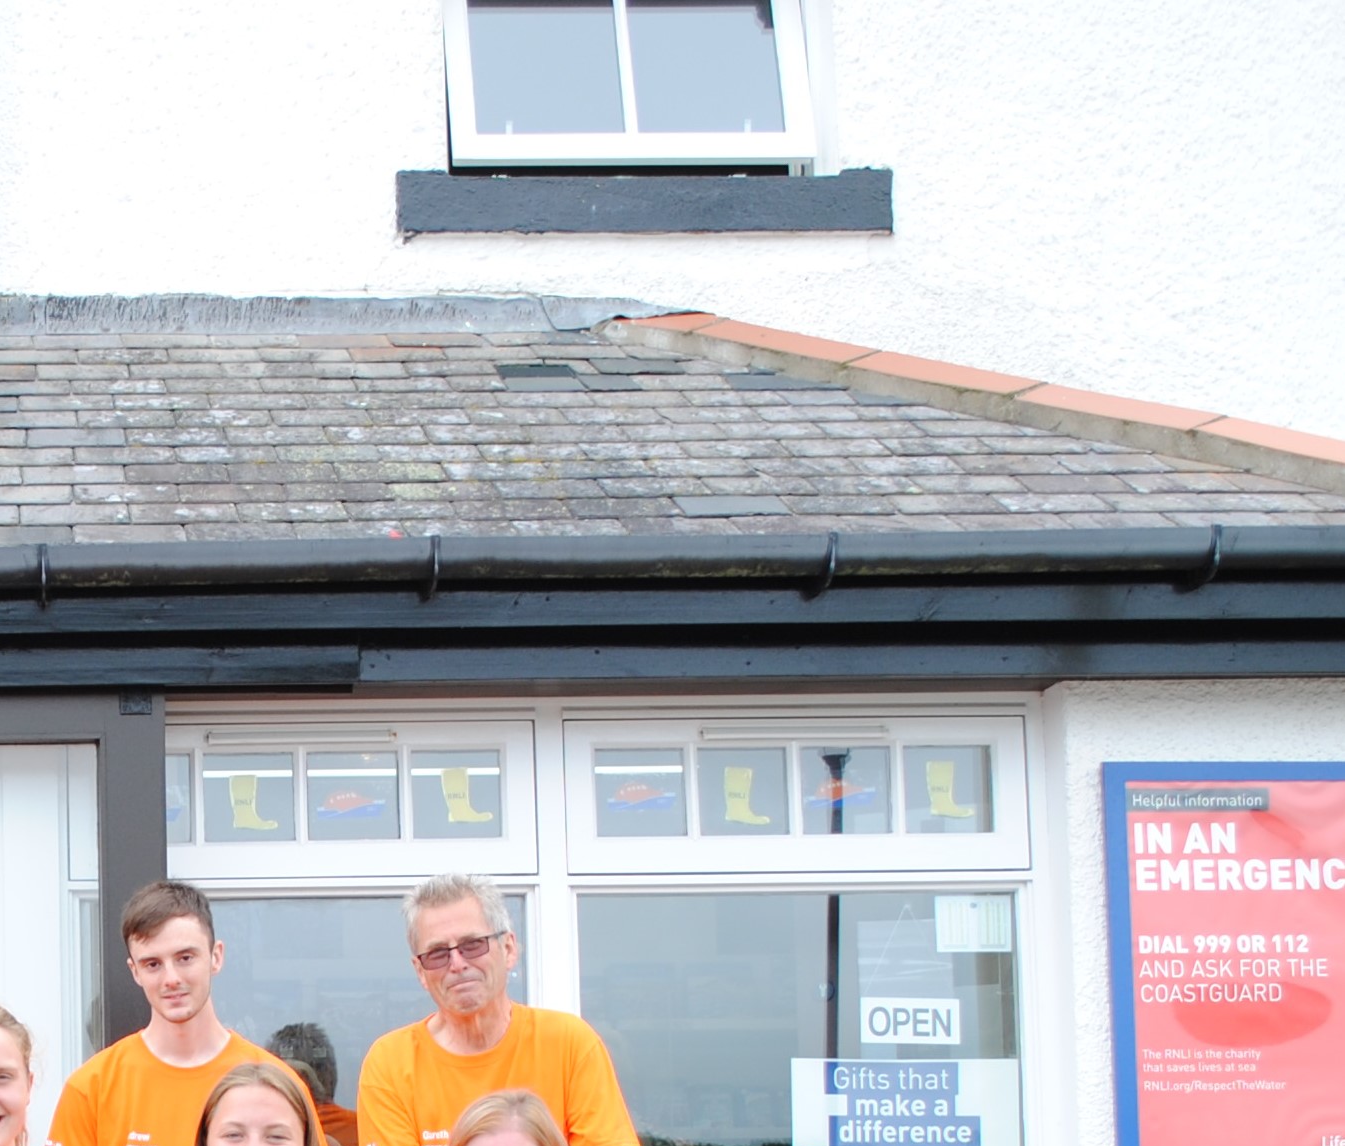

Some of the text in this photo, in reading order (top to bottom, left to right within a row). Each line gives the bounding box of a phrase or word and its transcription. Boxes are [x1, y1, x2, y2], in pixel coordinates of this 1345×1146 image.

[1132, 792, 1262, 809] Helpful information
[1134, 821, 1237, 855] IN AN
[1139, 934, 1309, 954] DIAL 999 OR 112
[1139, 958, 1328, 978] AND ASK FOR THE
[1141, 983, 1283, 1003] COASTGUARD
[868, 1007, 952, 1038] OPEN
[1142, 1048, 1261, 1061] The RNLI is the charity
[1143, 1062, 1256, 1072] that saves lives at sea
[833, 1068, 949, 1091] Gifts that
[1143, 1079, 1286, 1092] RNLI.org/RespectTheWater
[855, 1096, 949, 1117] make a
[839, 1119, 973, 1145] difference
